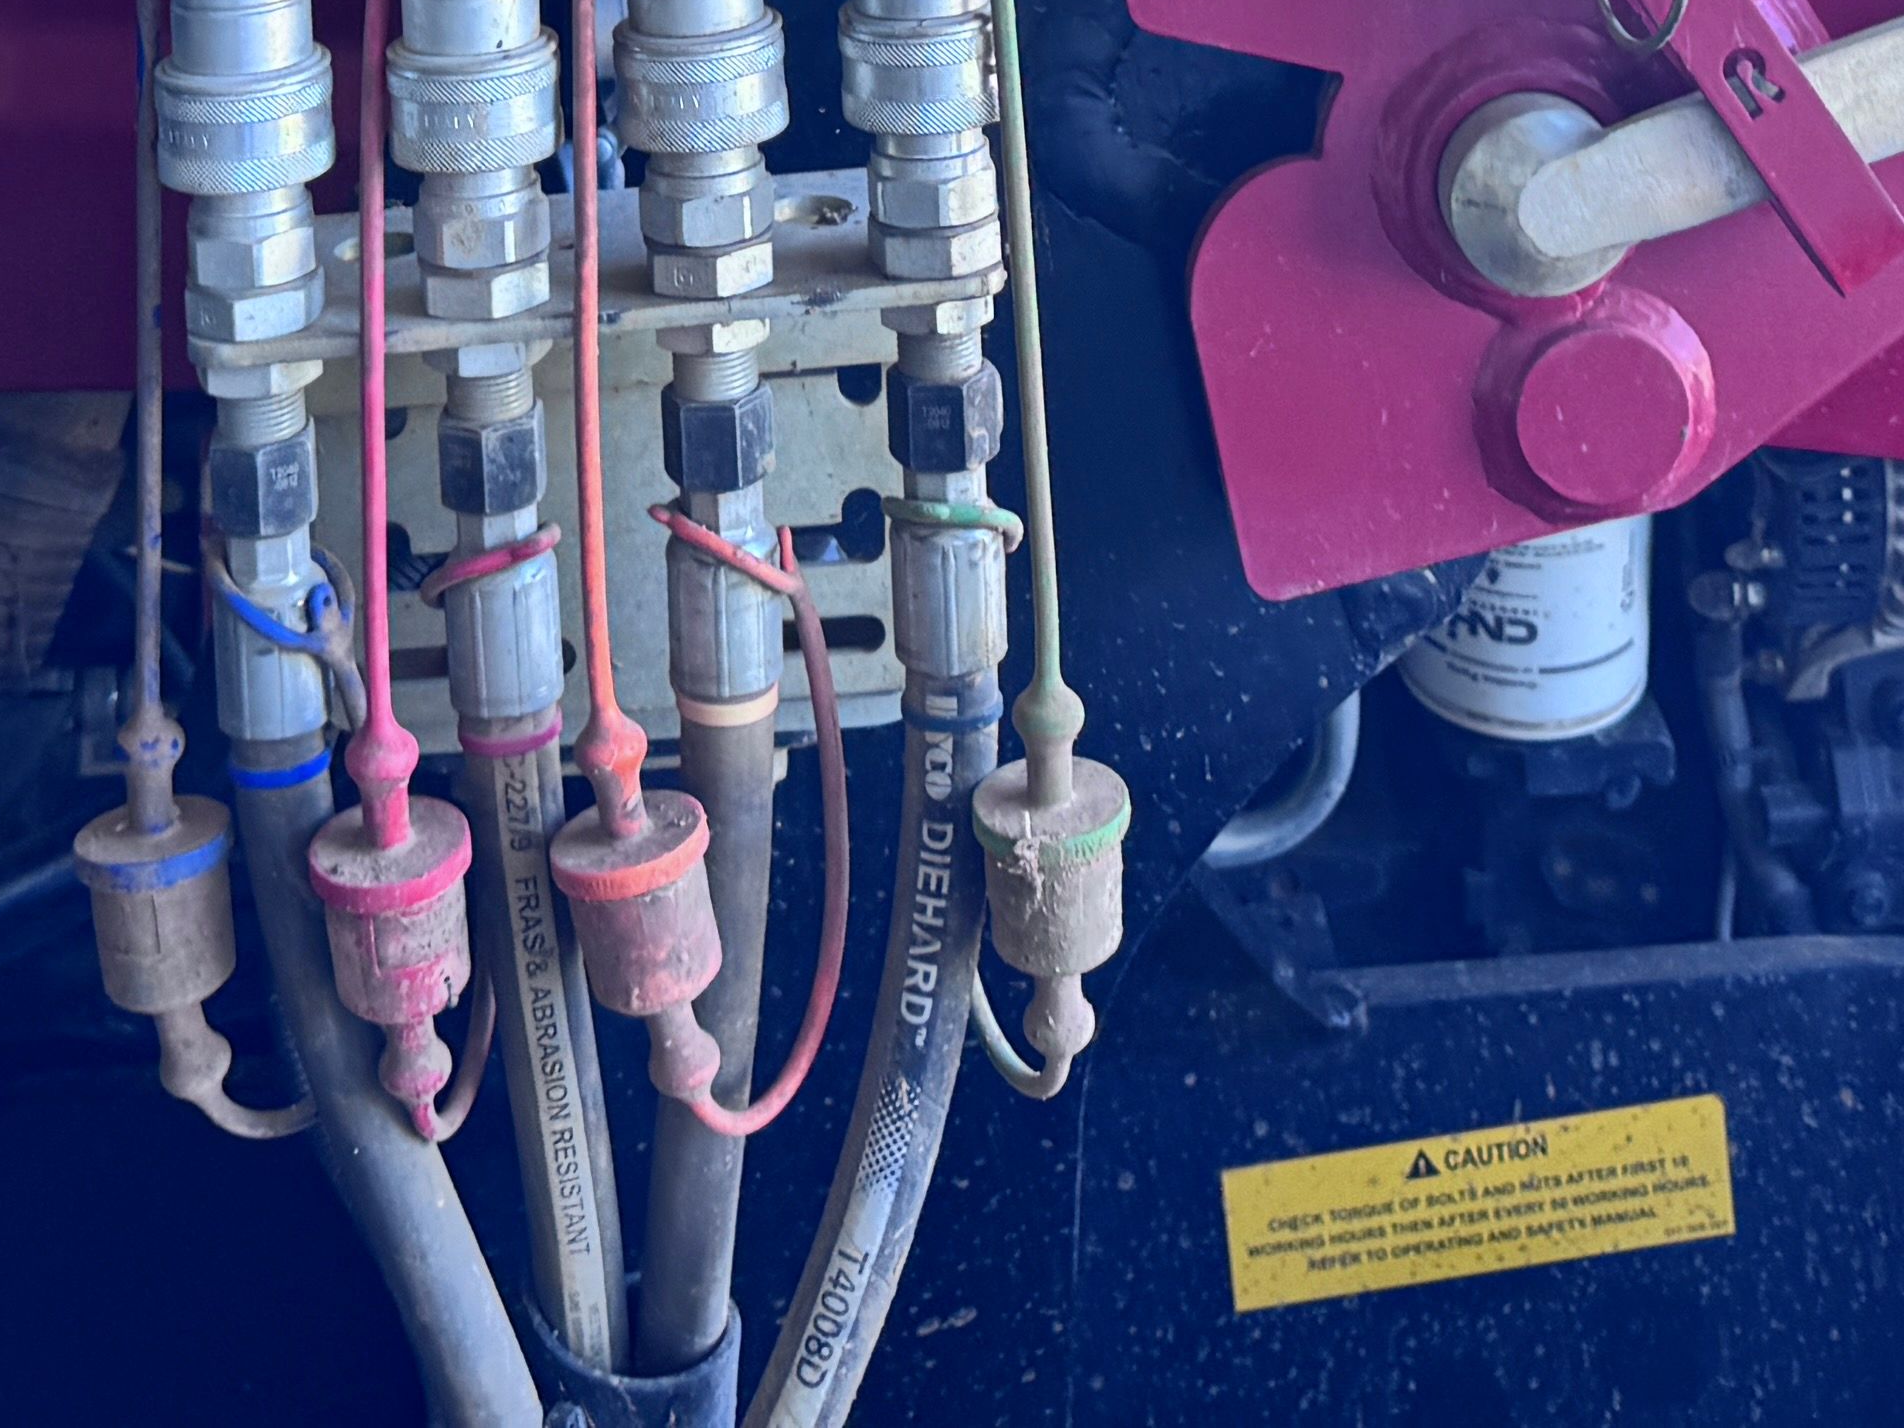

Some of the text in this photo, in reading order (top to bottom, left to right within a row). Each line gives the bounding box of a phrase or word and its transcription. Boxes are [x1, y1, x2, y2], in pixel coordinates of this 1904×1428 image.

[514, 874, 546, 957] FRAS
[525, 957, 542, 977] &
[529, 982, 571, 1121] ABRASION
[1443, 1134, 1549, 1172] CAUTION
[1565, 1165, 1619, 1186] AFTER
[552, 1129, 591, 1259] RESISTANT
